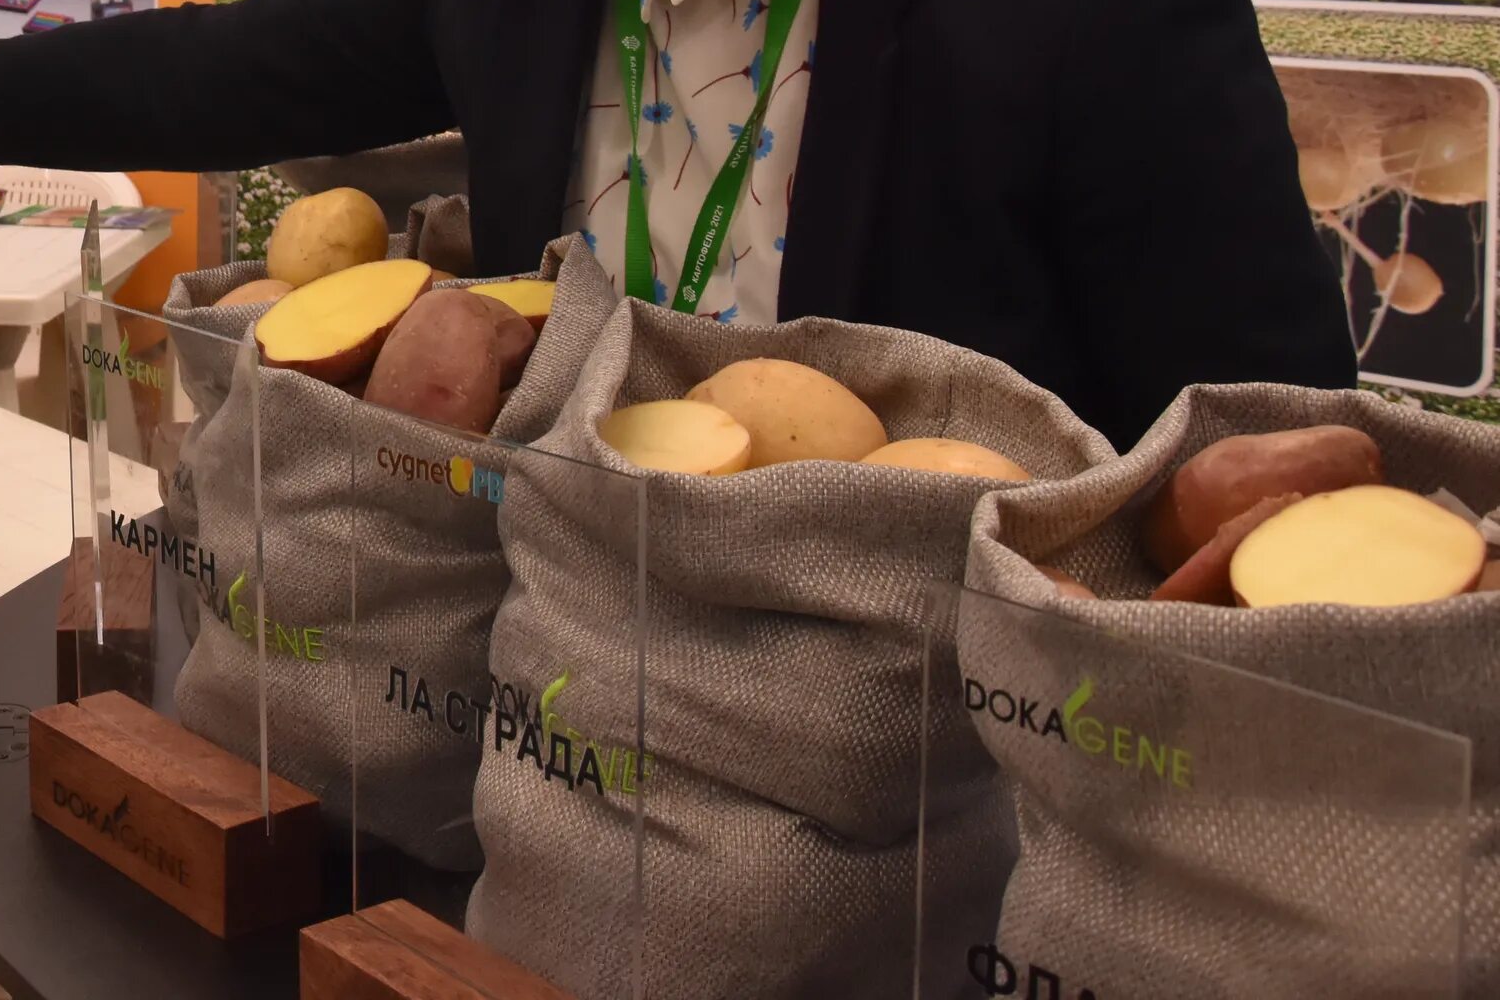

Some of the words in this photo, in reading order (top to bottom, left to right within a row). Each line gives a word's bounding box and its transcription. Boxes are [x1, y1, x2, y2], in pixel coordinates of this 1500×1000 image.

[691, 227, 717, 284] КАРТОФЕЛЬ
[710, 204, 725, 228] 2021
[111, 510, 216, 586] КАРМЕН
[386, 665, 434, 722] ЛА
[444, 690, 604, 796] СТРАДА
[965, 678, 1193, 790] DOKAGENE
[967, 943, 1097, 1000] ФЛ
